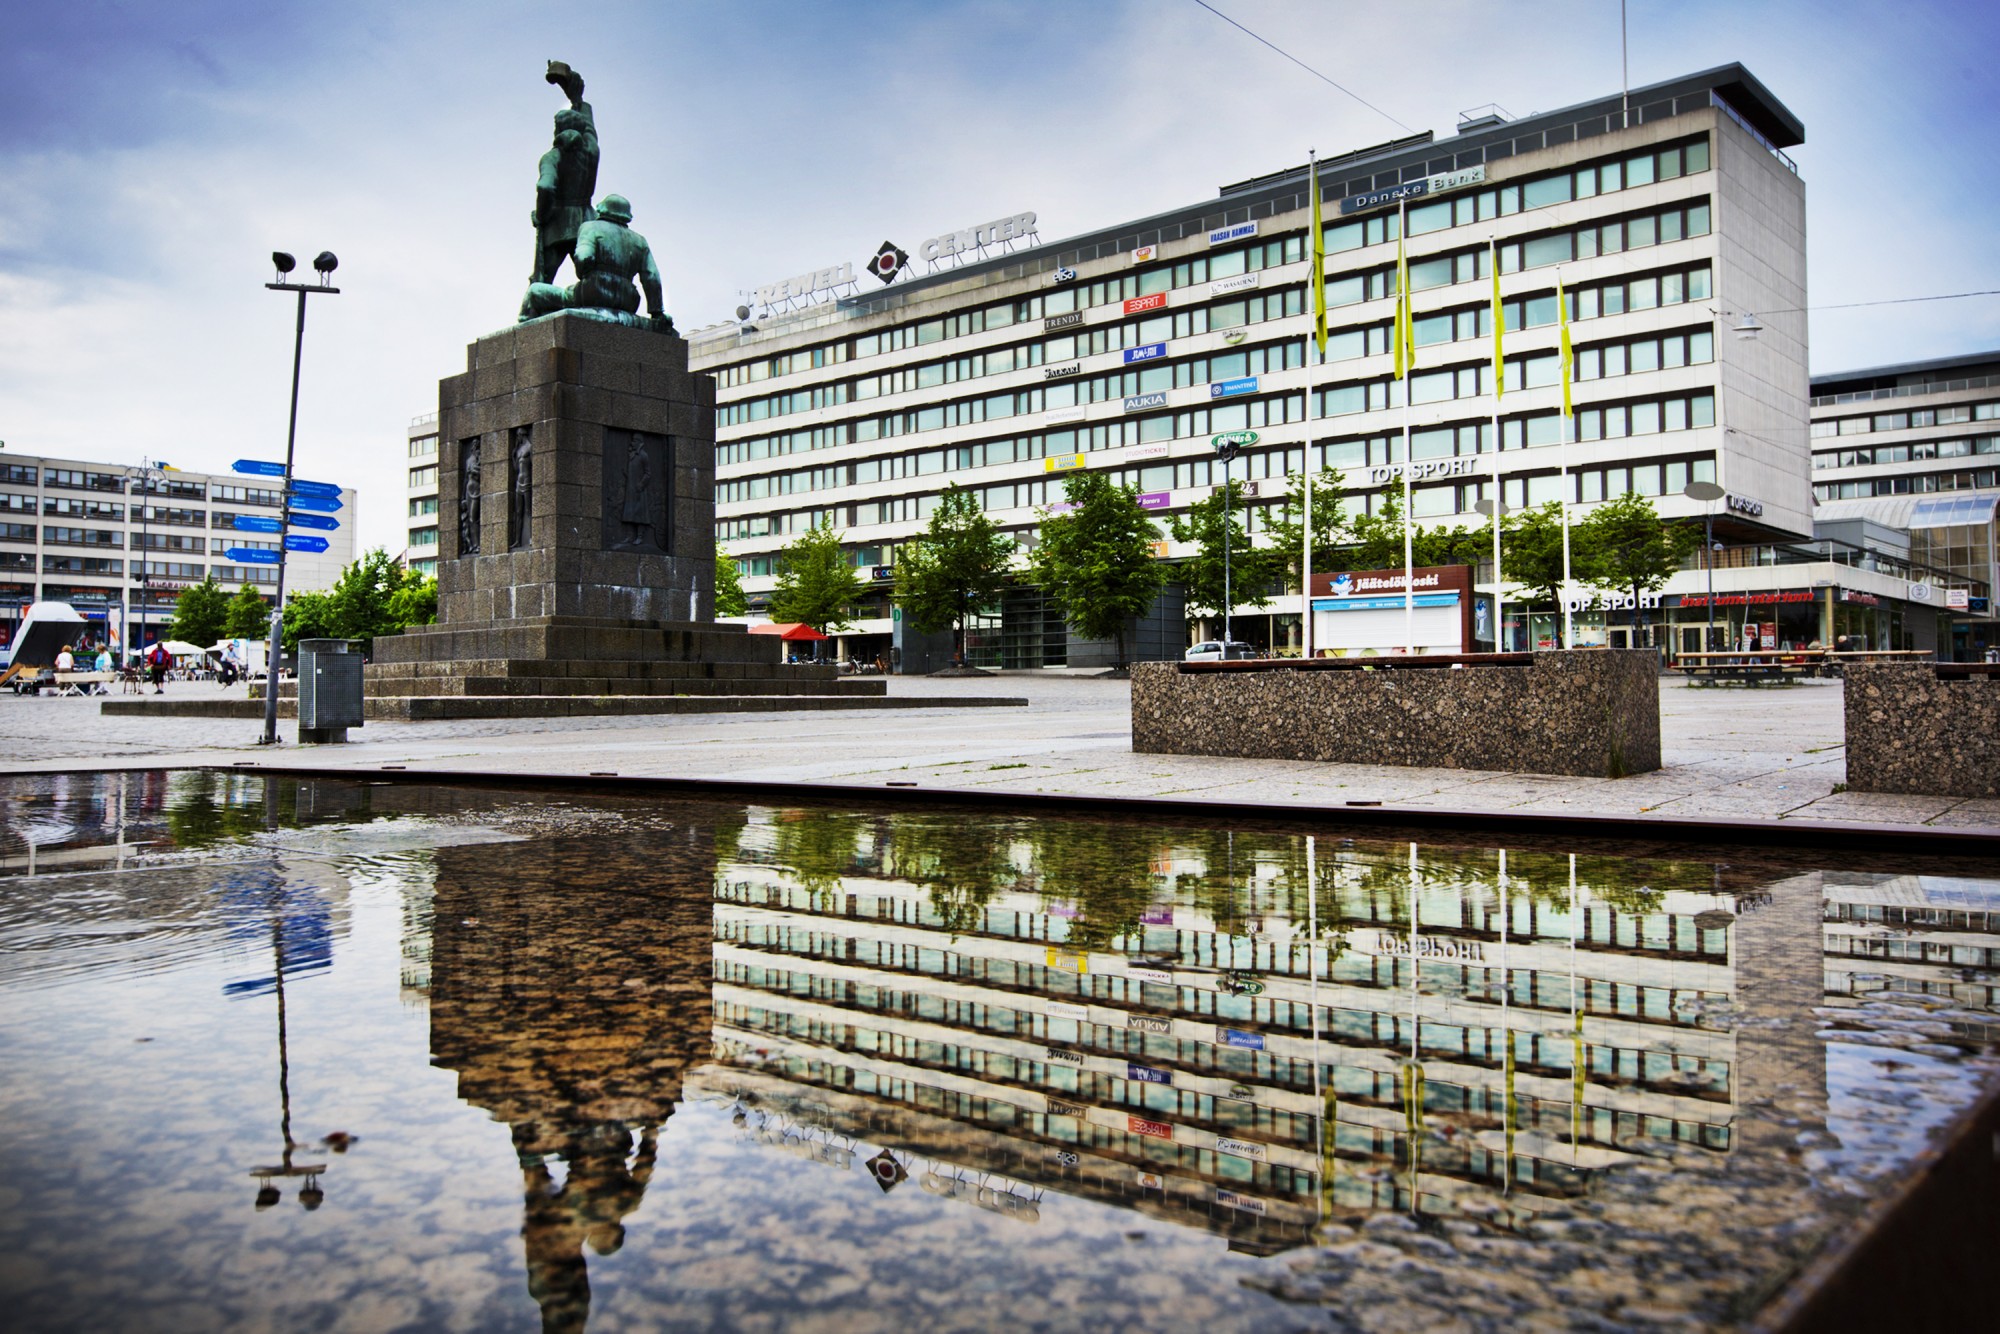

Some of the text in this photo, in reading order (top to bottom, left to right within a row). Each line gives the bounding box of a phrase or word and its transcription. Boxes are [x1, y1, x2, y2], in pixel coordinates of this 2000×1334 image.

[1356, 170, 1481, 207] Danske Bank
[1210, 223, 1255, 243] VAASAN HAMMAS
[757, 211, 1038, 308] REWELL CENTER
[1053, 267, 1075, 283] elisa
[1129, 295, 1160, 311] ESPRIT
[1126, 395, 1164, 409] AUKIA
[893, 609, 901, 622] D
